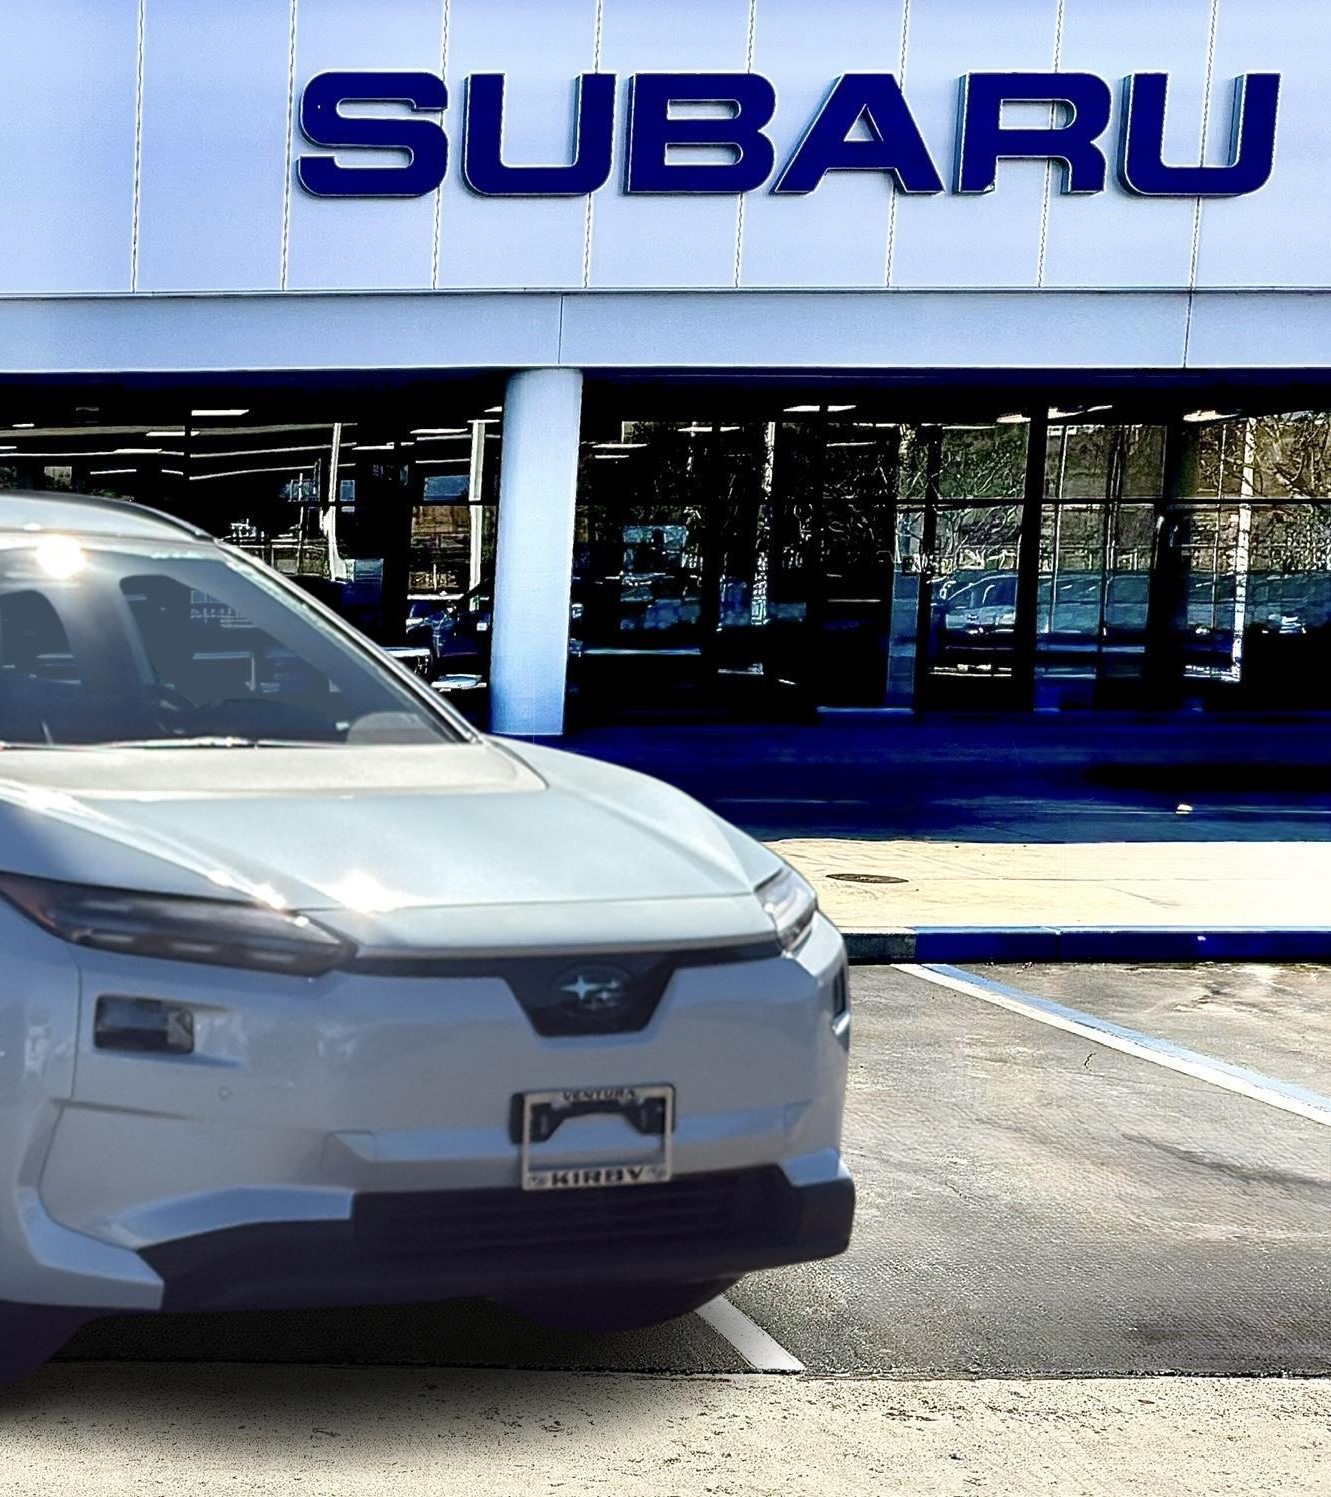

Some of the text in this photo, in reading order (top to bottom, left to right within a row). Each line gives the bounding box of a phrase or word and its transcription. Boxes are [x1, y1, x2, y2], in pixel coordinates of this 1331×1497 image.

[297, 72, 1282, 198] SUBARU
[563, 1088, 637, 1102] VENTURA
[551, 1168, 644, 1186] KIRBY
